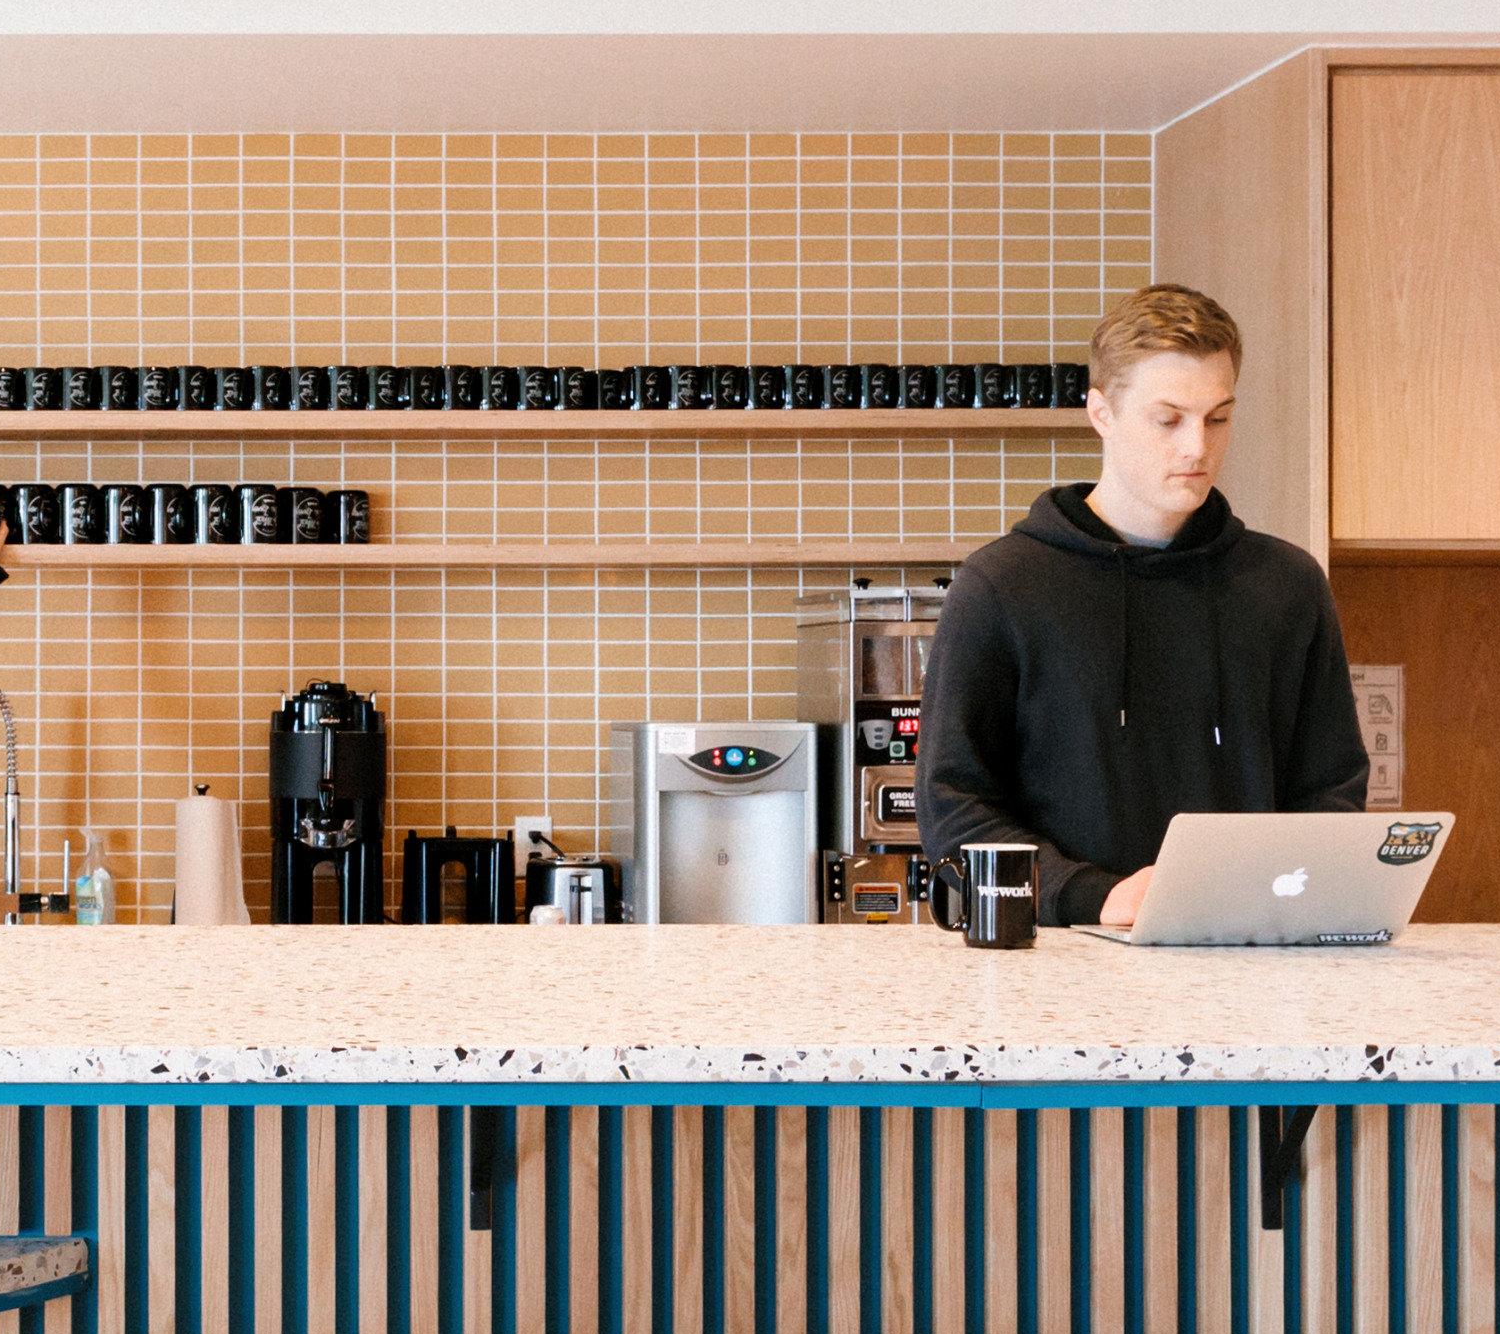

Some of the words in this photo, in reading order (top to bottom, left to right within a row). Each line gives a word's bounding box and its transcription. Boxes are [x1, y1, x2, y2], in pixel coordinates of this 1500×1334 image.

[889, 791, 915, 800] GROU
[893, 800, 916, 808] FRES
[1380, 845, 1430, 856] DENVER
[977, 881, 1033, 898] wework
[1318, 929, 1392, 943] wework
